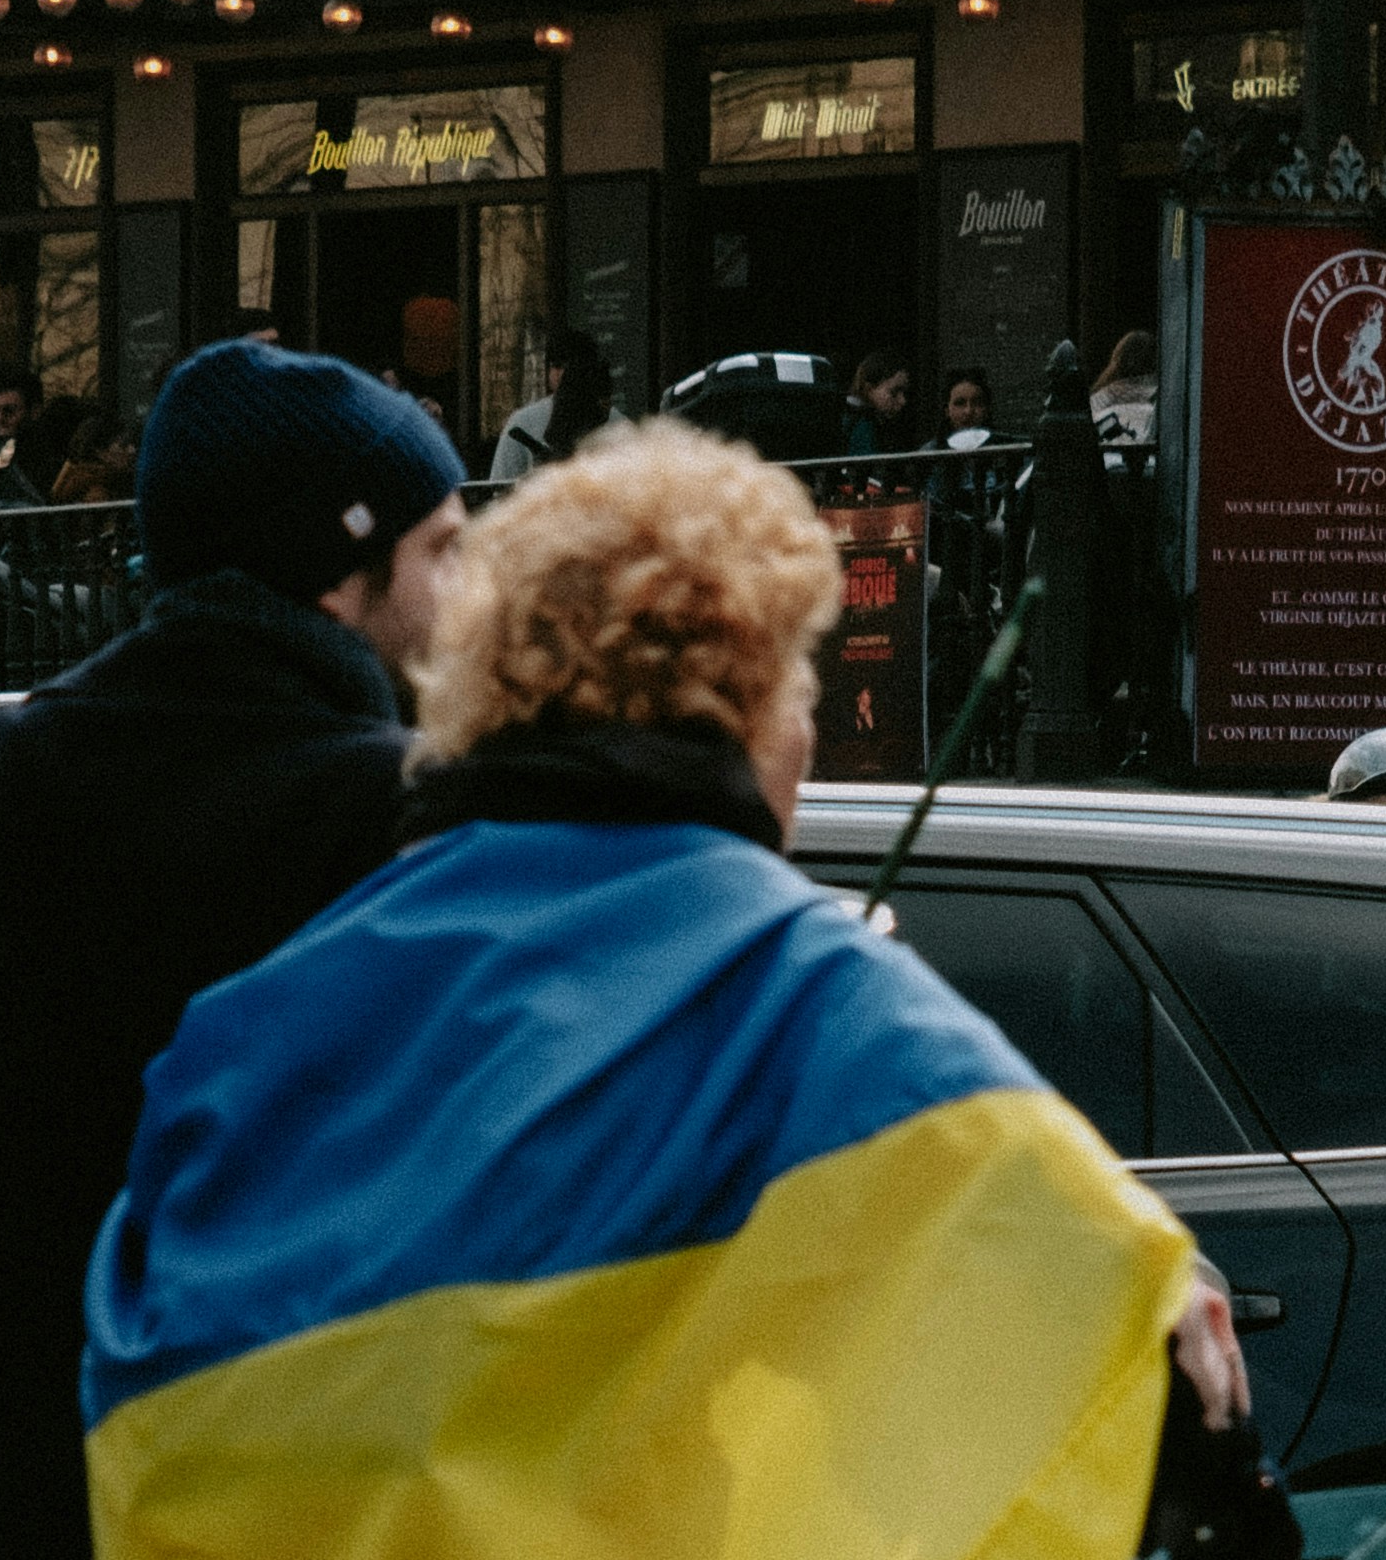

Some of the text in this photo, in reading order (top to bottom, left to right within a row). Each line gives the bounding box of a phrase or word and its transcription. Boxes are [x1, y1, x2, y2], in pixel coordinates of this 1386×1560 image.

[761, 93, 884, 141] Midi-Minuit
[307, 120, 496, 182] Bouillon République
[63, 145, 100, 191] 7/7
[958, 189, 1046, 237] Bouillon
[1335, 466, 1386, 495] 1770
[1224, 500, 1253, 514] NON
[1255, 500, 1331, 515] SEULEMENT
[1316, 526, 1334, 541] DU
[1227, 548, 1236, 562] Y
[1239, 548, 1249, 562] A
[1250, 548, 1266, 562] LE
[1268, 548, 1305, 562] FRUIT
[1308, 549, 1326, 563] DE
[1328, 549, 1354, 563] VOS
[1361, 590, 1379, 605] LE
[1259, 609, 1323, 624] VIRGINIE
[1333, 662, 1375, 677] C'EST
[1229, 693, 1268, 709] MAIS,
[1271, 693, 1292, 708] EN
[1294, 693, 1371, 709] BEAUCOUP
[1248, 725, 1286, 741] PEUT
